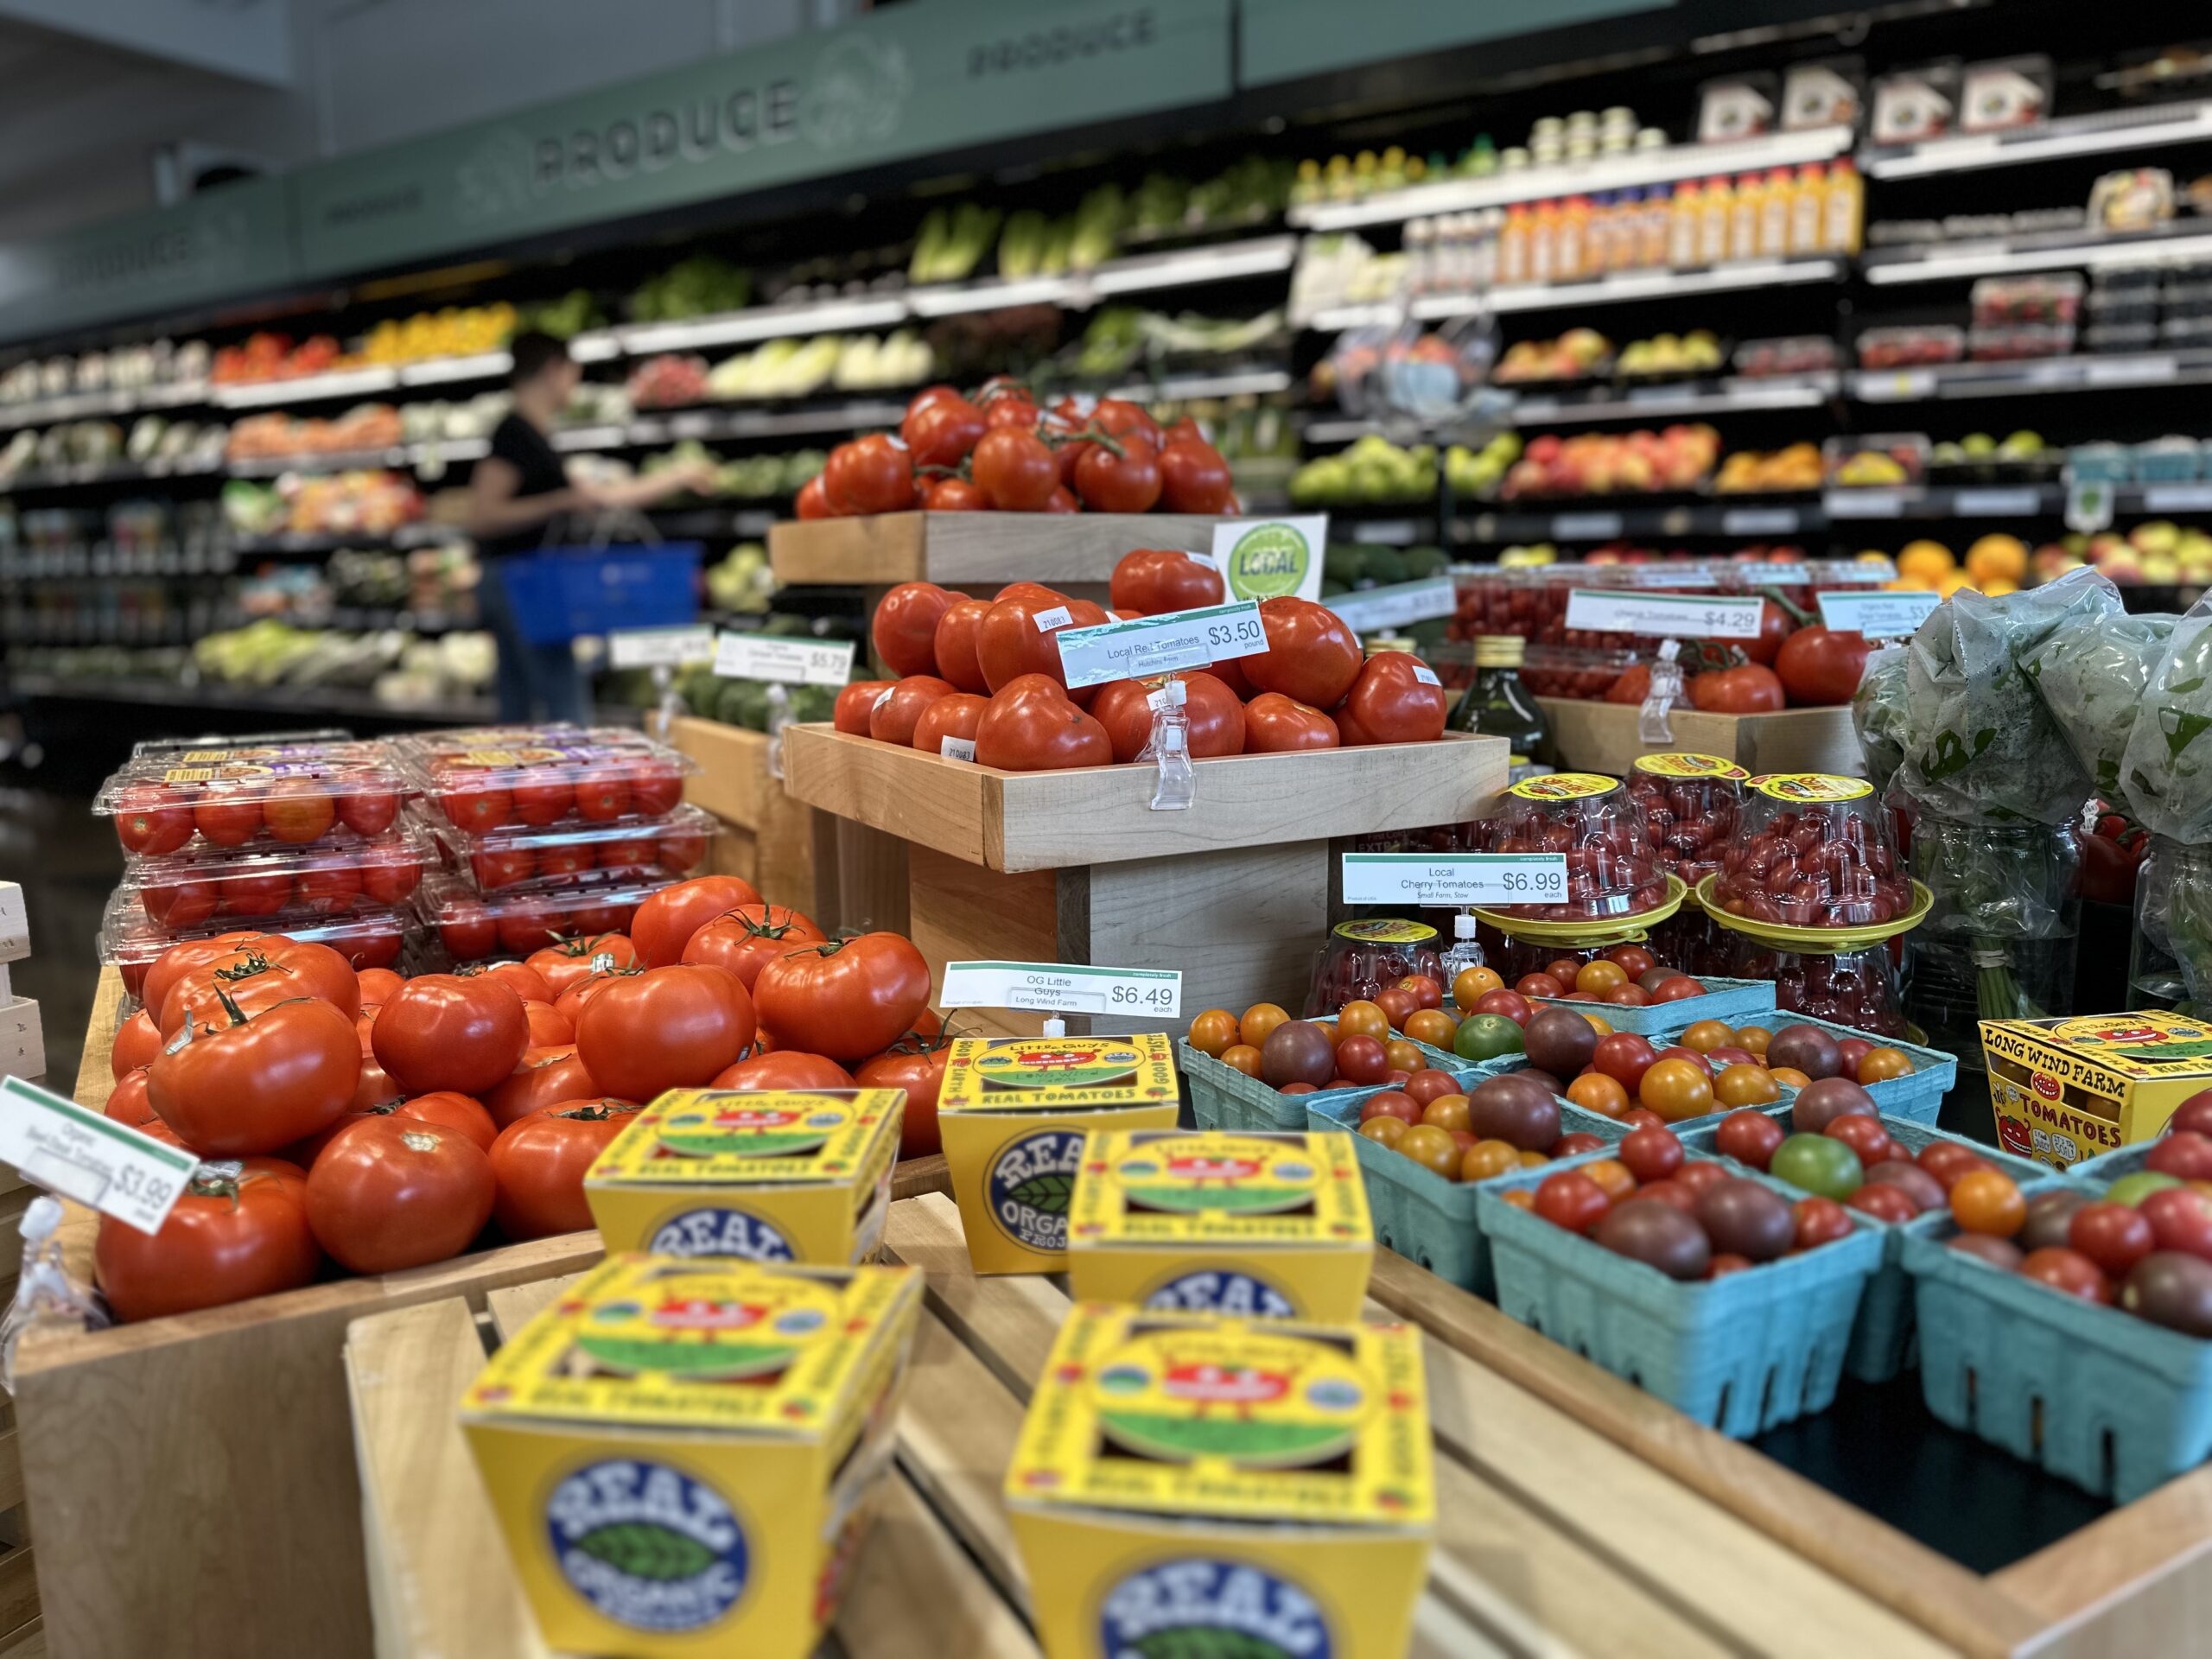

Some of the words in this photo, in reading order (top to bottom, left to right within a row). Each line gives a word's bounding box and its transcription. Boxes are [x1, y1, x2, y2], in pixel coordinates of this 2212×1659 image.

[967, 8, 1157, 78] PRODUCE
[532, 76, 802, 185] PRODUCE
[1239, 550, 1299, 576] LOCAL
[1704, 611, 1756, 628] $4.29
[1209, 620, 1261, 645] $3.50
[1108, 644, 1133, 659] Local
[1156, 635, 1199, 651] Tomatoes
[1243, 639, 1264, 649] pound
[949, 747, 970, 760] 210083
[1428, 868, 1455, 877] Local
[1503, 872, 1561, 891] $6.99
[1401, 880, 1433, 891] Cherry
[1436, 880, 1484, 889] Tomatoes
[1027, 976, 1045, 985] OG
[1047, 976, 1071, 987] Little
[1034, 987, 1061, 997] Guys
[1015, 996, 1035, 1005] Long
[1111, 985, 1173, 1006] $6.49
[956, 1040, 974, 1057] GOOD
[1151, 1062, 1171, 1084] GOOD
[1985, 1028, 2025, 1059] LONG
[2028, 1046, 2070, 1076] WIND
[2072, 1064, 2126, 1097] FARM
[2152, 1064, 2193, 1073] REAL
[982, 1093, 1024, 1104] REAL
[1031, 1088, 1135, 1103] TOMATOES
[2019, 1092, 2122, 1148] TOMATOES
[995, 1135, 1086, 1189] REA
[114, 1162, 172, 1211] $3.99
[1001, 1200, 1068, 1236] ORGA
[649, 1209, 796, 1260] REAL
[1020, 1228, 1067, 1249] PROJ
[548, 1459, 736, 1551] REAL
[1102, 1560, 1328, 1653] REAL
